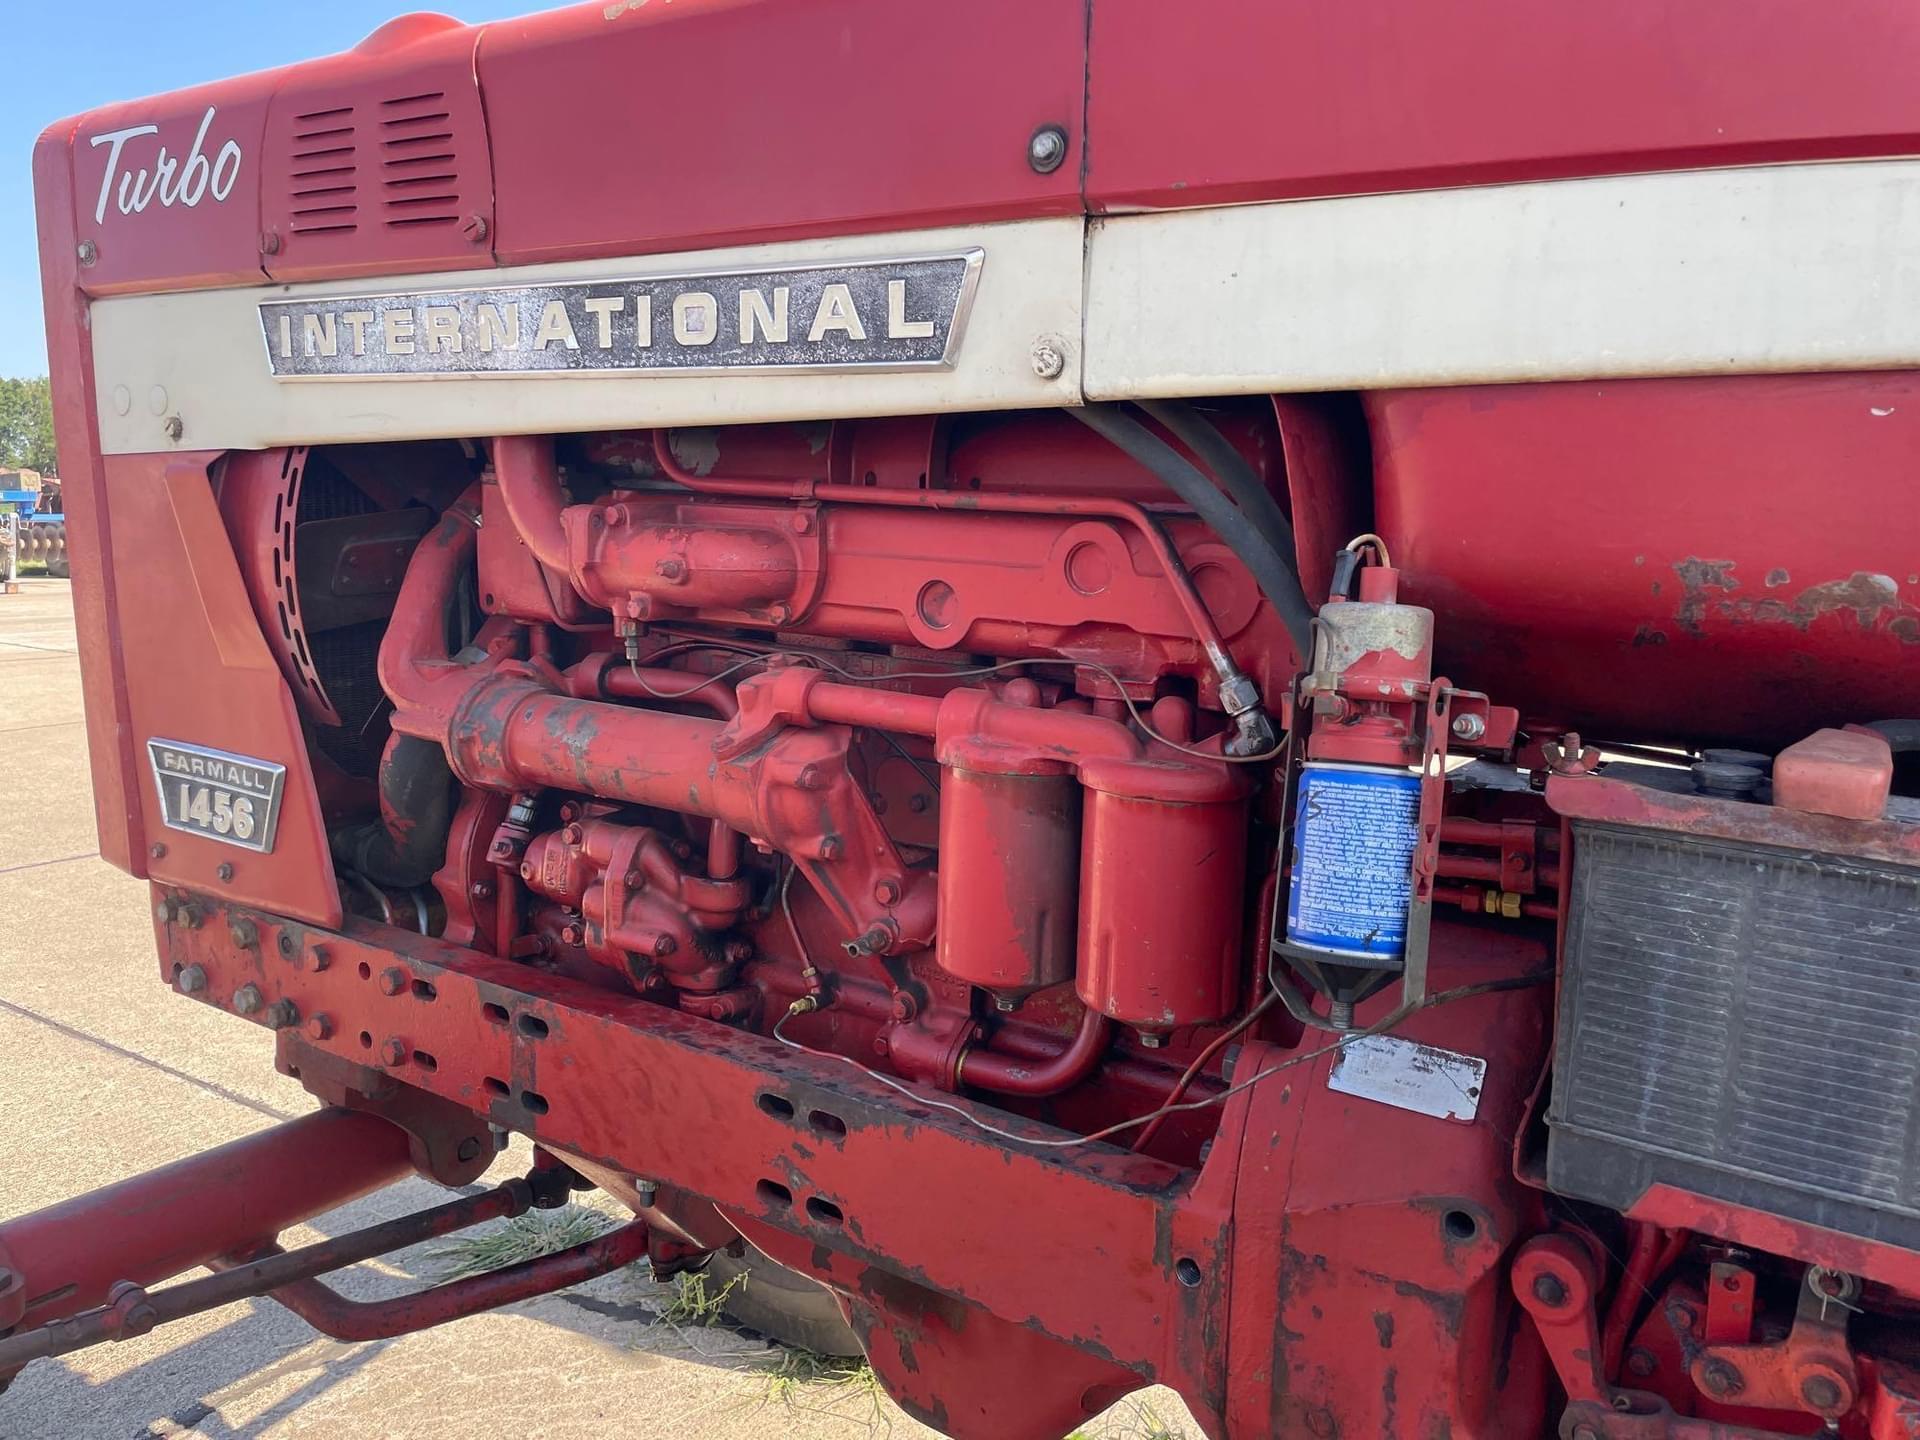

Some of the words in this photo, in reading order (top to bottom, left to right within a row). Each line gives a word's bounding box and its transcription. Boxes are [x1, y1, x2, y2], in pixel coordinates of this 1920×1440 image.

[90, 105, 241, 224] Turbo
[280, 280, 935, 357] INTERNATIONAL
[163, 752, 265, 789] FARMALL
[180, 784, 255, 839] 1456
